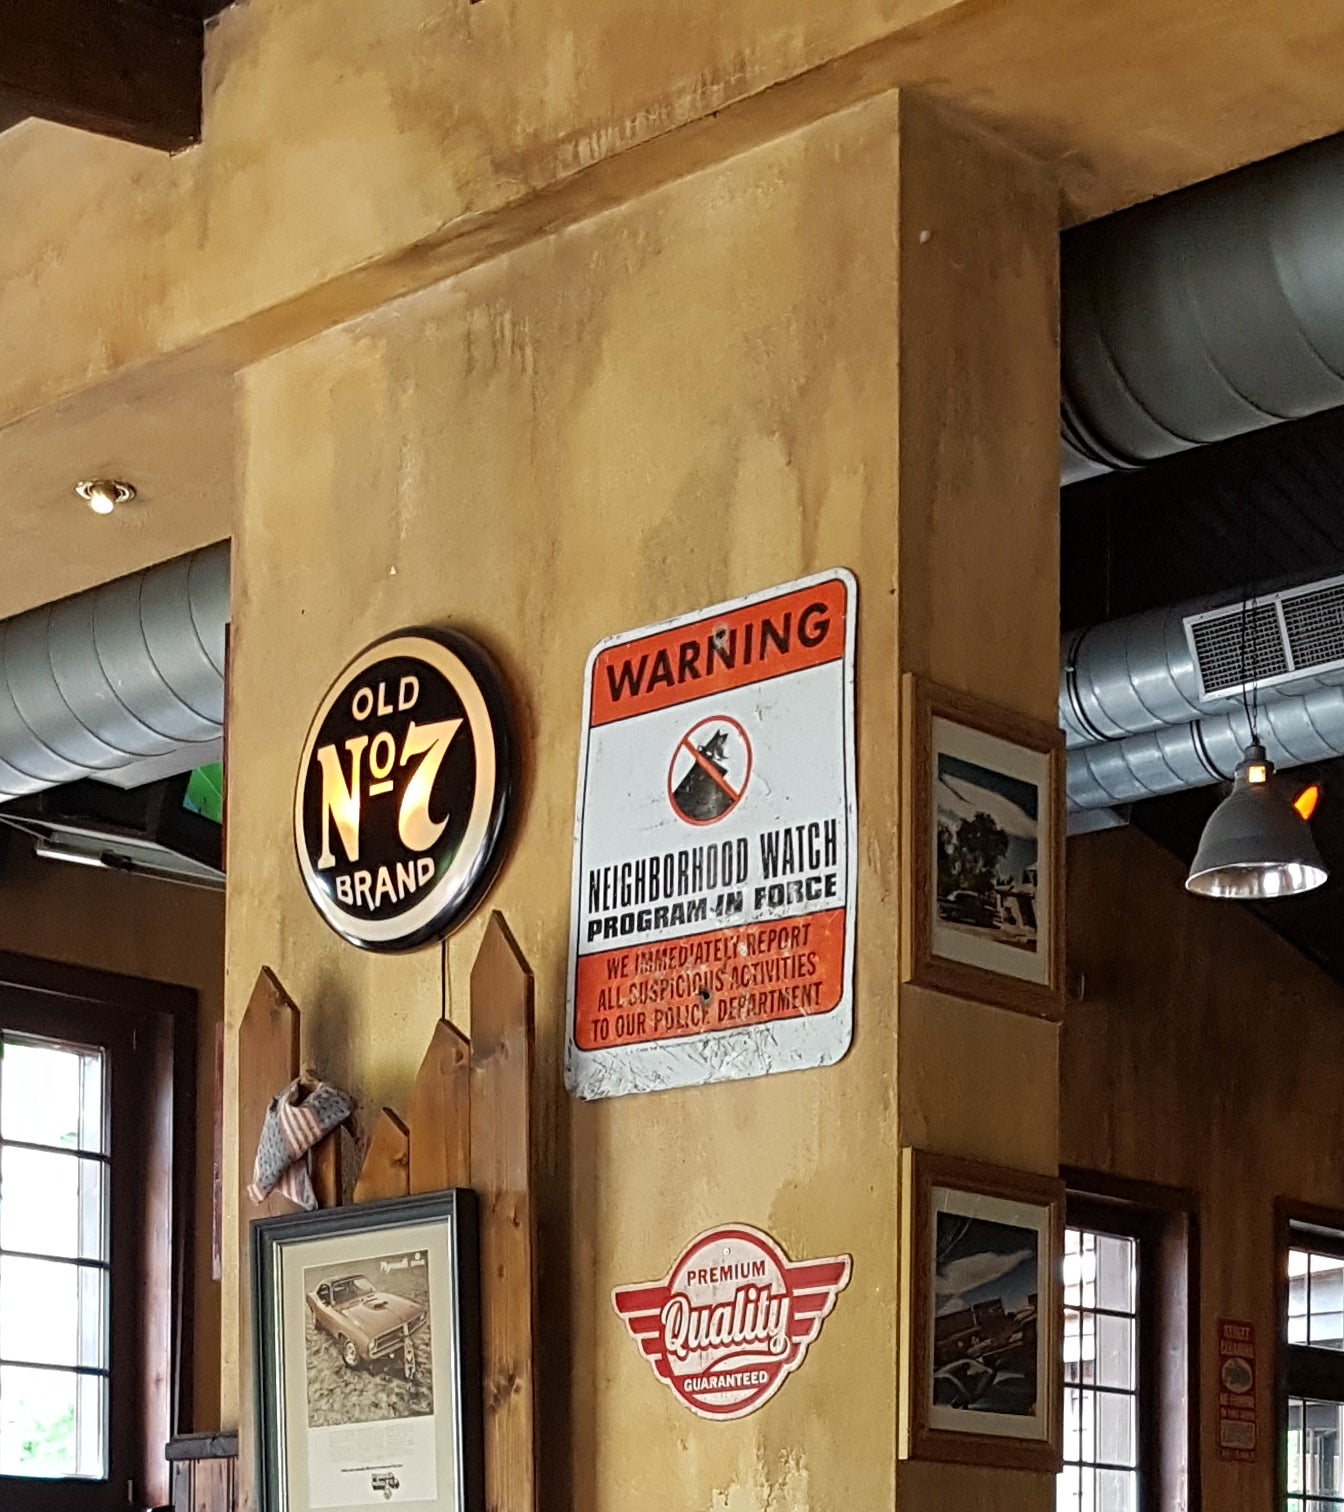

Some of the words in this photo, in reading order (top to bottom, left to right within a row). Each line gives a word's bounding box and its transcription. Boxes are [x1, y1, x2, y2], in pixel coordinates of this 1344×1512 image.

[606, 601, 831, 702] WARNING
[352, 675, 420, 721] OLD
[335, 856, 435, 912] BRAND
[587, 837, 749, 914] NEIGHBORHOOD
[759, 818, 838, 881] WATCH
[586, 897, 708, 943] PROGRAM
[714, 890, 744, 918] IN
[754, 872, 838, 911] FORCE
[596, 987, 624, 1013] ALL
[628, 969, 725, 1007] SUSPICIOUS
[729, 951, 817, 990] ACTIVITIES
[606, 958, 629, 981] WE
[634, 935, 740, 976] IMMEDIATELY
[745, 922, 812, 957] REPORT
[590, 1017, 610, 1042] TO
[614, 1011, 647, 1037] OUR
[653, 1003, 709, 1034] POLICE
[717, 980, 824, 1023] DEPARTMENT
[686, 1259, 767, 1287] PREMIUM
[661, 1285, 790, 1357] Quality
[683, 1370, 769, 1392] GUARANTEED
